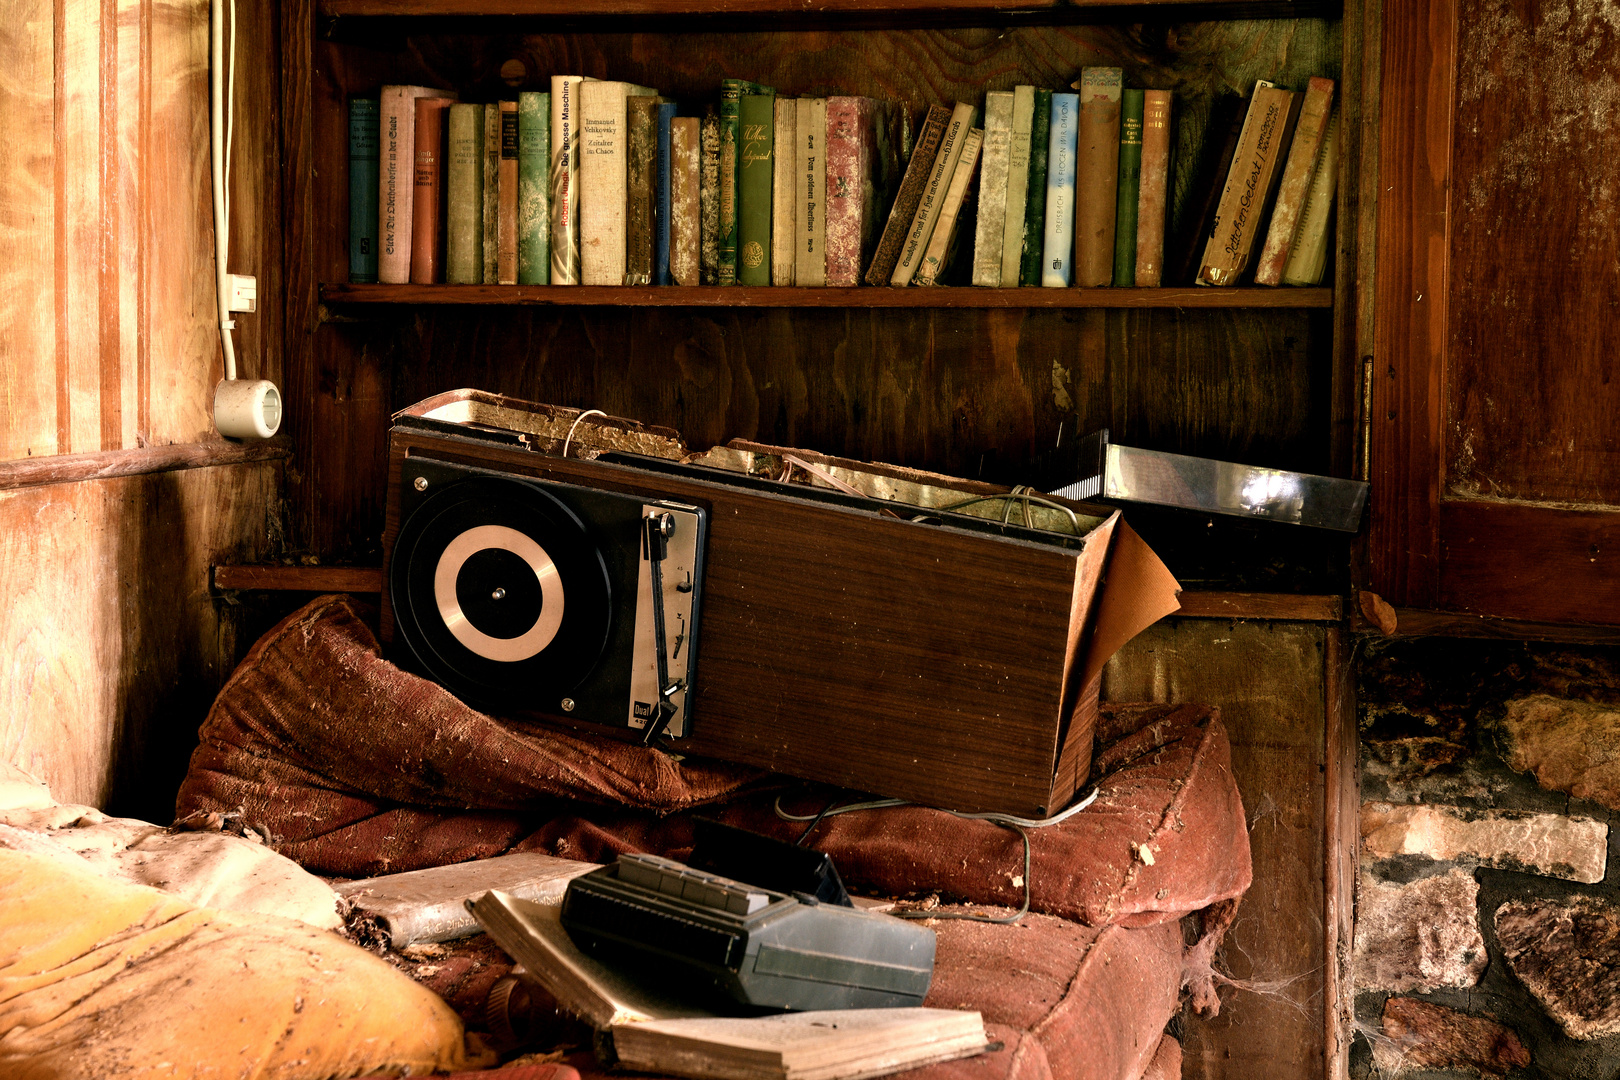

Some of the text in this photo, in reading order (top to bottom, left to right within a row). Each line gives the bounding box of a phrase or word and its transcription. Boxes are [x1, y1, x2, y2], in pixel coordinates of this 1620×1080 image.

[389, 116, 397, 139] Stadt
[561, 171, 570, 196] Jungk
[1241, 160, 1262, 208] Gebert
[561, 200, 569, 226] Robert
[1056, 196, 1064, 234] DREISBACH
[635, 704, 650, 716] Dual
